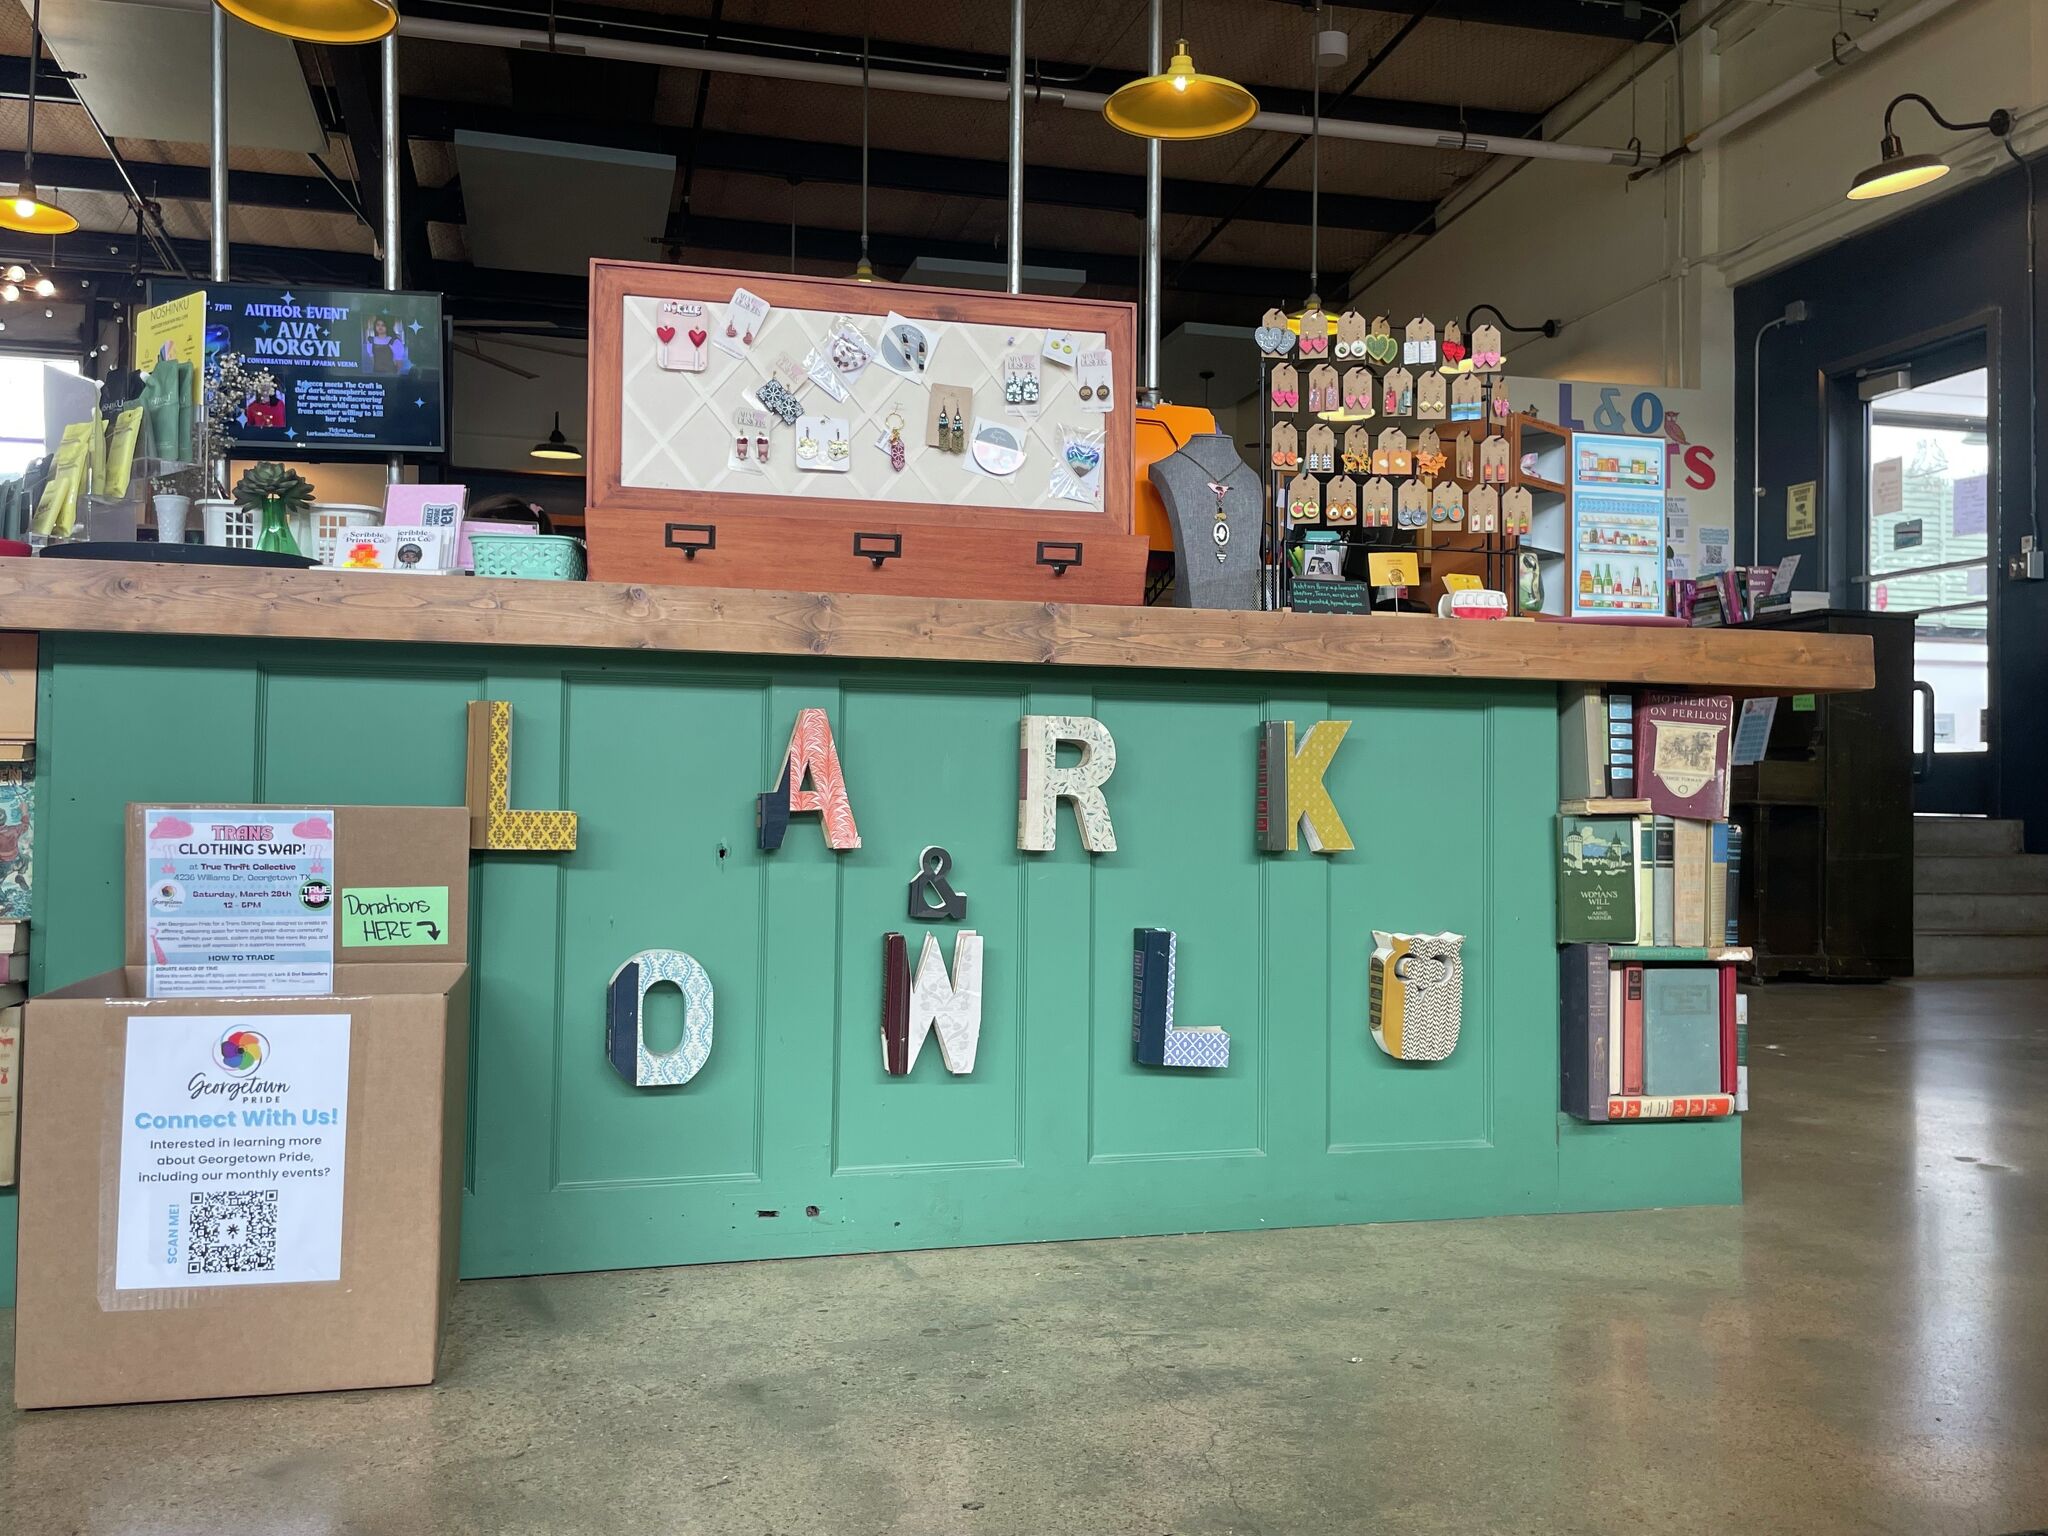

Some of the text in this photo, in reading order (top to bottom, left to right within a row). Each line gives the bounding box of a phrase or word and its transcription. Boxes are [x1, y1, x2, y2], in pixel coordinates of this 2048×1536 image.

[214, 303, 232, 311] 7pm
[245, 304, 349, 320] AUTHOR EVENT
[277, 321, 318, 339] AVA
[255, 338, 341, 357] MORGYN
[1651, 694, 1728, 709] MOTHERING
[1650, 707, 1728, 721] ON PERILOUS
[212, 825, 274, 841] TRANS
[179, 843, 306, 856] CLOTHING SWAP!
[248, 874, 297, 882] Georgetown
[909, 846, 967, 920] &
[344, 894, 430, 915] Donations
[364, 920, 412, 942] HERE
[187, 1072, 290, 1101] Georgetown
[242, 1096, 281, 1104] PRIDE
[135, 1107, 338, 1129] Connect With Us!
[150, 1136, 322, 1150] Interested in learning more
[157, 1152, 314, 1167] about Georgetown Pride,
[138, 1167, 331, 1184] including our monthly events?
[167, 1204, 180, 1264] SCAN ME!
